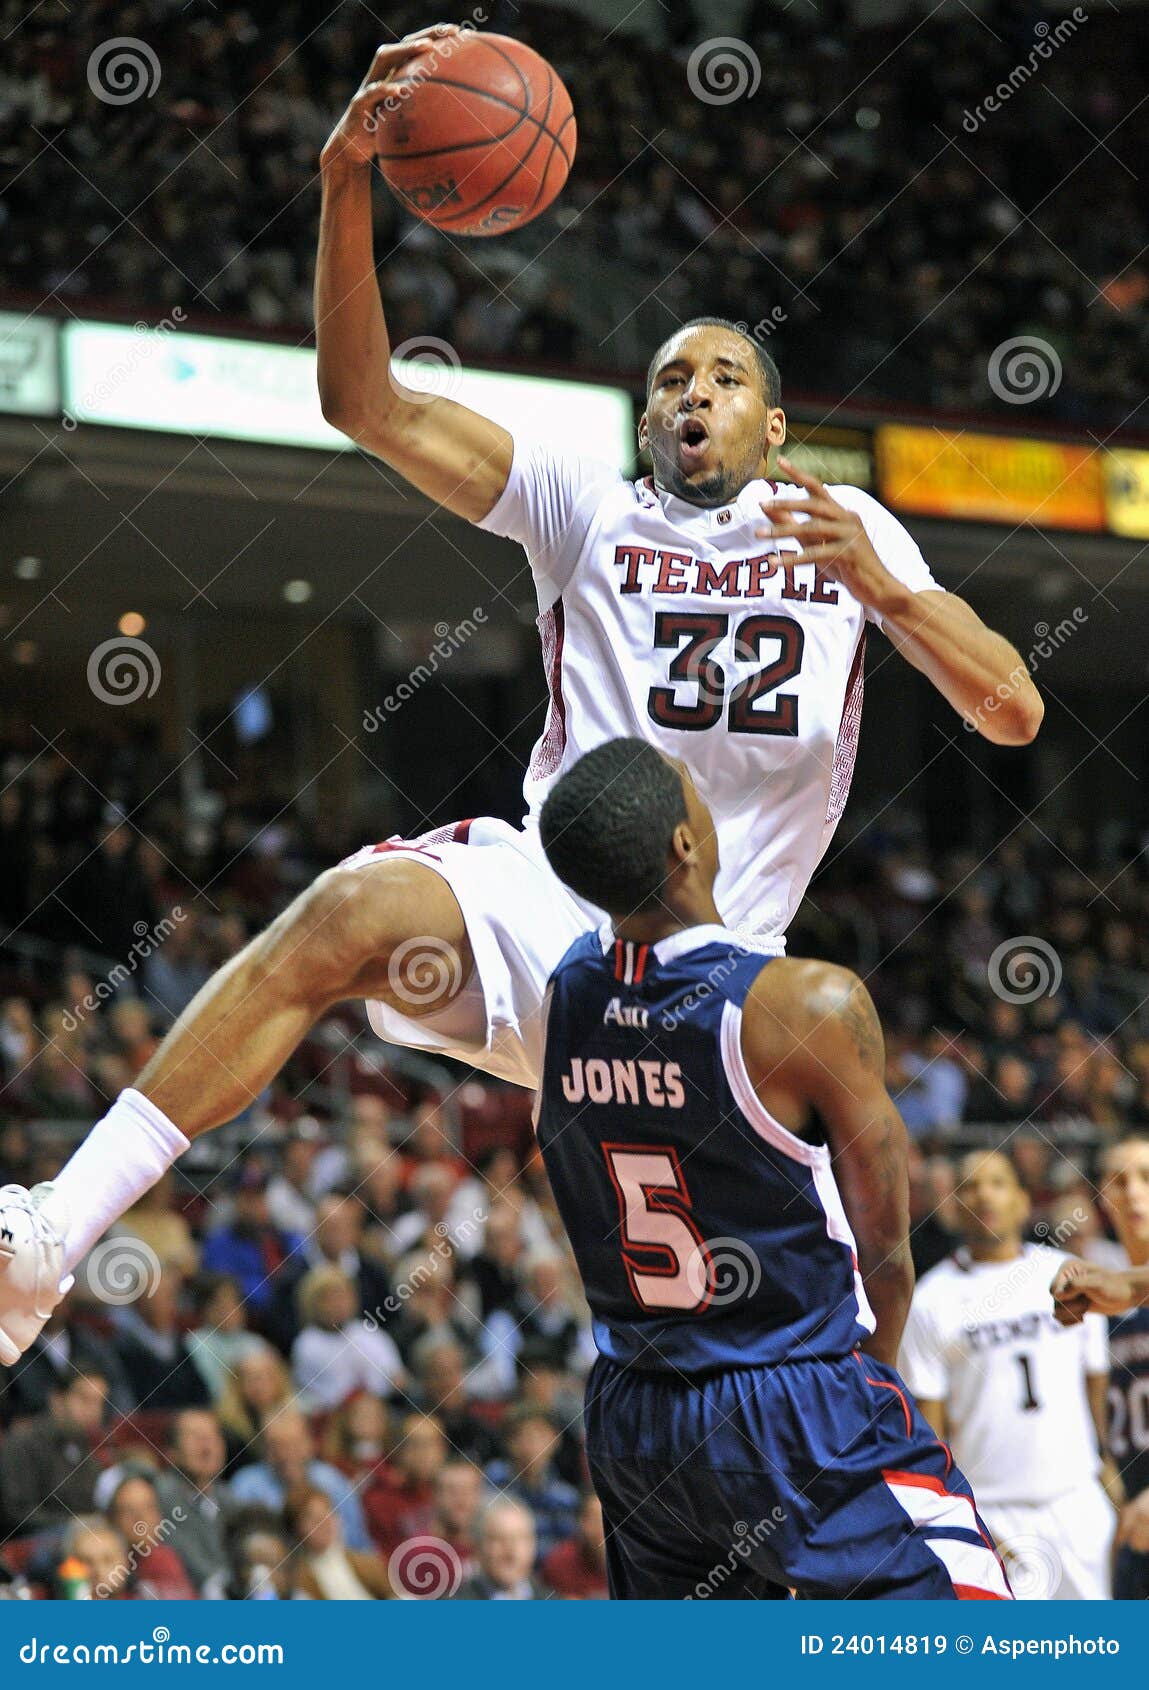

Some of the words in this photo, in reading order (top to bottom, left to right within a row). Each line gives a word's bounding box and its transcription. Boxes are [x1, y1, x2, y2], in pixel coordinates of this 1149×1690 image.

[647, 611, 805, 737] 32
[561, 1057, 686, 1109] JONES
[601, 1141, 717, 1313] 5
[1015, 1352, 1040, 1414] 1
